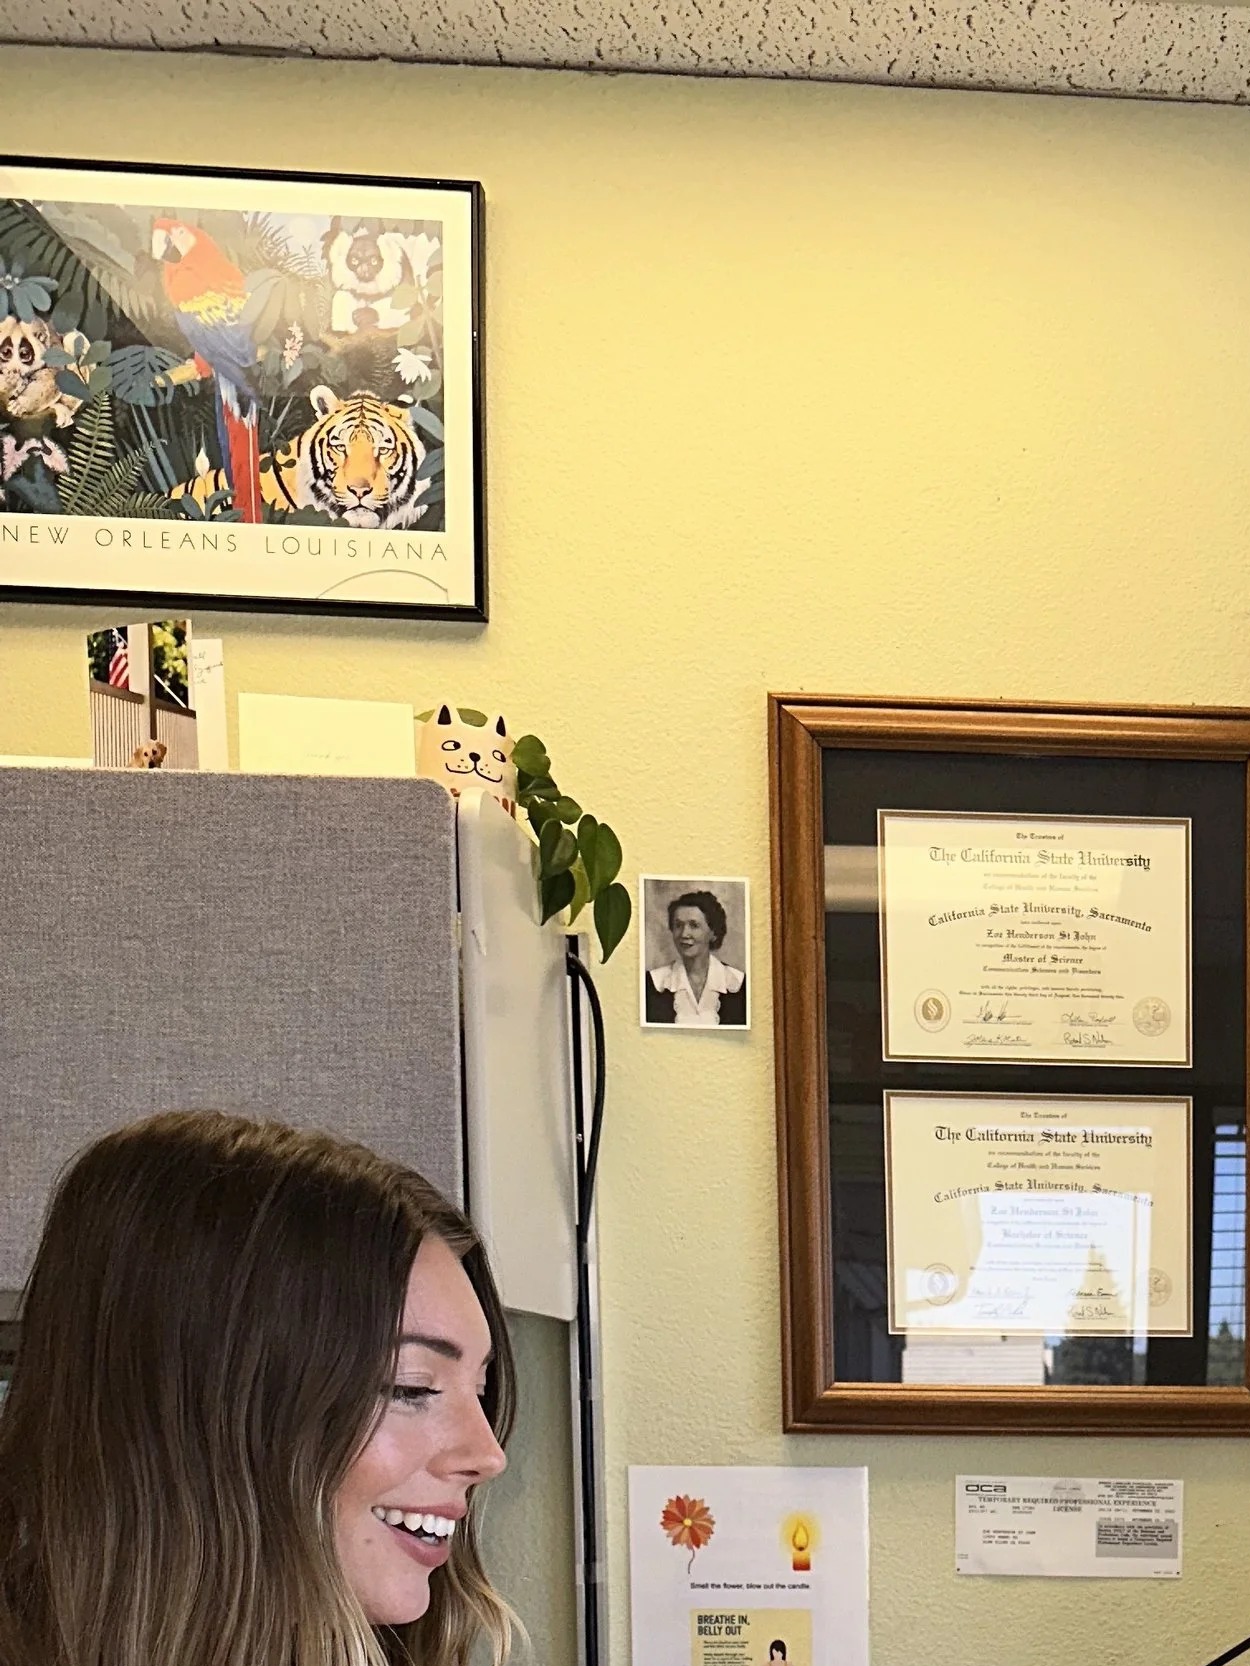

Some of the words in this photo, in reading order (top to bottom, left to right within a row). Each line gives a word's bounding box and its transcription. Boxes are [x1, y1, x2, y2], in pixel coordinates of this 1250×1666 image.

[3, 524, 69, 544] NEW
[95, 528, 237, 553] ORLEANS
[265, 535, 448, 561] LOUISIANA
[929, 846, 956, 866] The
[961, 848, 1031, 863] California
[1035, 849, 1073, 866] State
[1078, 850, 1151, 871] University
[928, 907, 985, 926] California
[988, 903, 1019, 917] State
[1022, 902, 1084, 918] University,
[1086, 906, 1152, 932] Sacramento
[1006, 929, 1055, 939] Henderson
[1002, 953, 1035, 962] Master
[1037, 954, 1047, 963] of
[935, 1126, 961, 1144] The
[965, 1127, 1034, 1142] California
[1038, 1129, 1077, 1145] State
[1081, 1129, 1152, 1147] University
[934, 1184, 990, 1203] California
[994, 1180, 1023, 1191] State
[697, 1615, 735, 1625] BREATHE
[738, 1615, 750, 1626] IN,
[697, 1625, 722, 1636] BELLY
[725, 1625, 742, 1635] OUT
